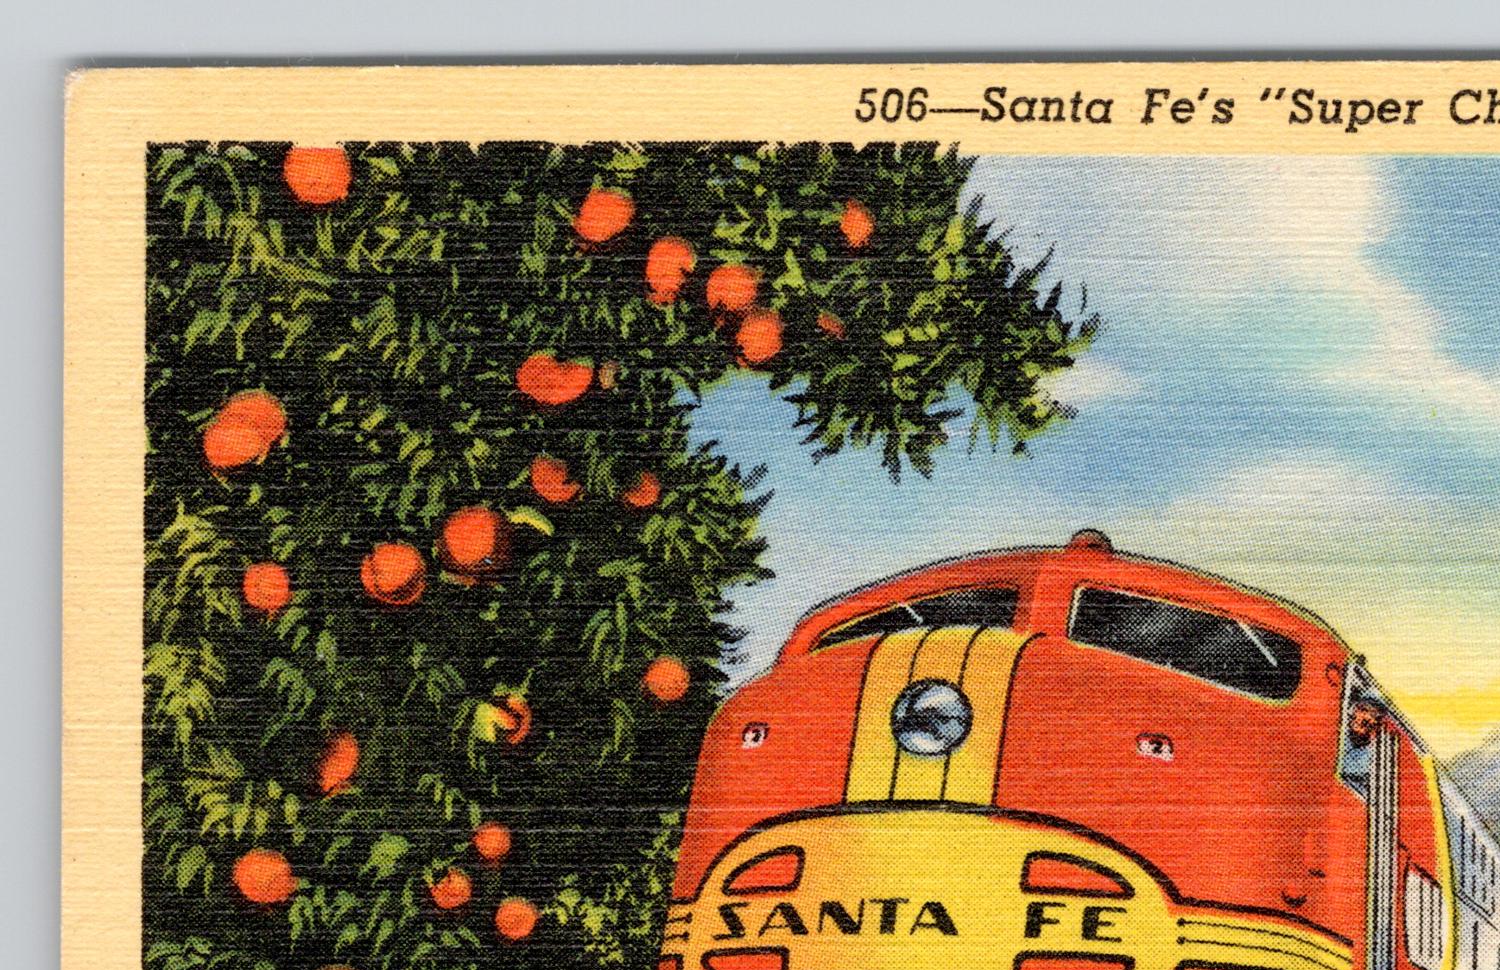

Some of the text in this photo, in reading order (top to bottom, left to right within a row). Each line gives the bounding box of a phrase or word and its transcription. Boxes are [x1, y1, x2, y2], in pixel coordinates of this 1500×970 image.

[1140, 87, 1235, 126] Fe's
[1260, 87, 1424, 134] "Super
[713, 898, 1128, 943] SANTA FE
